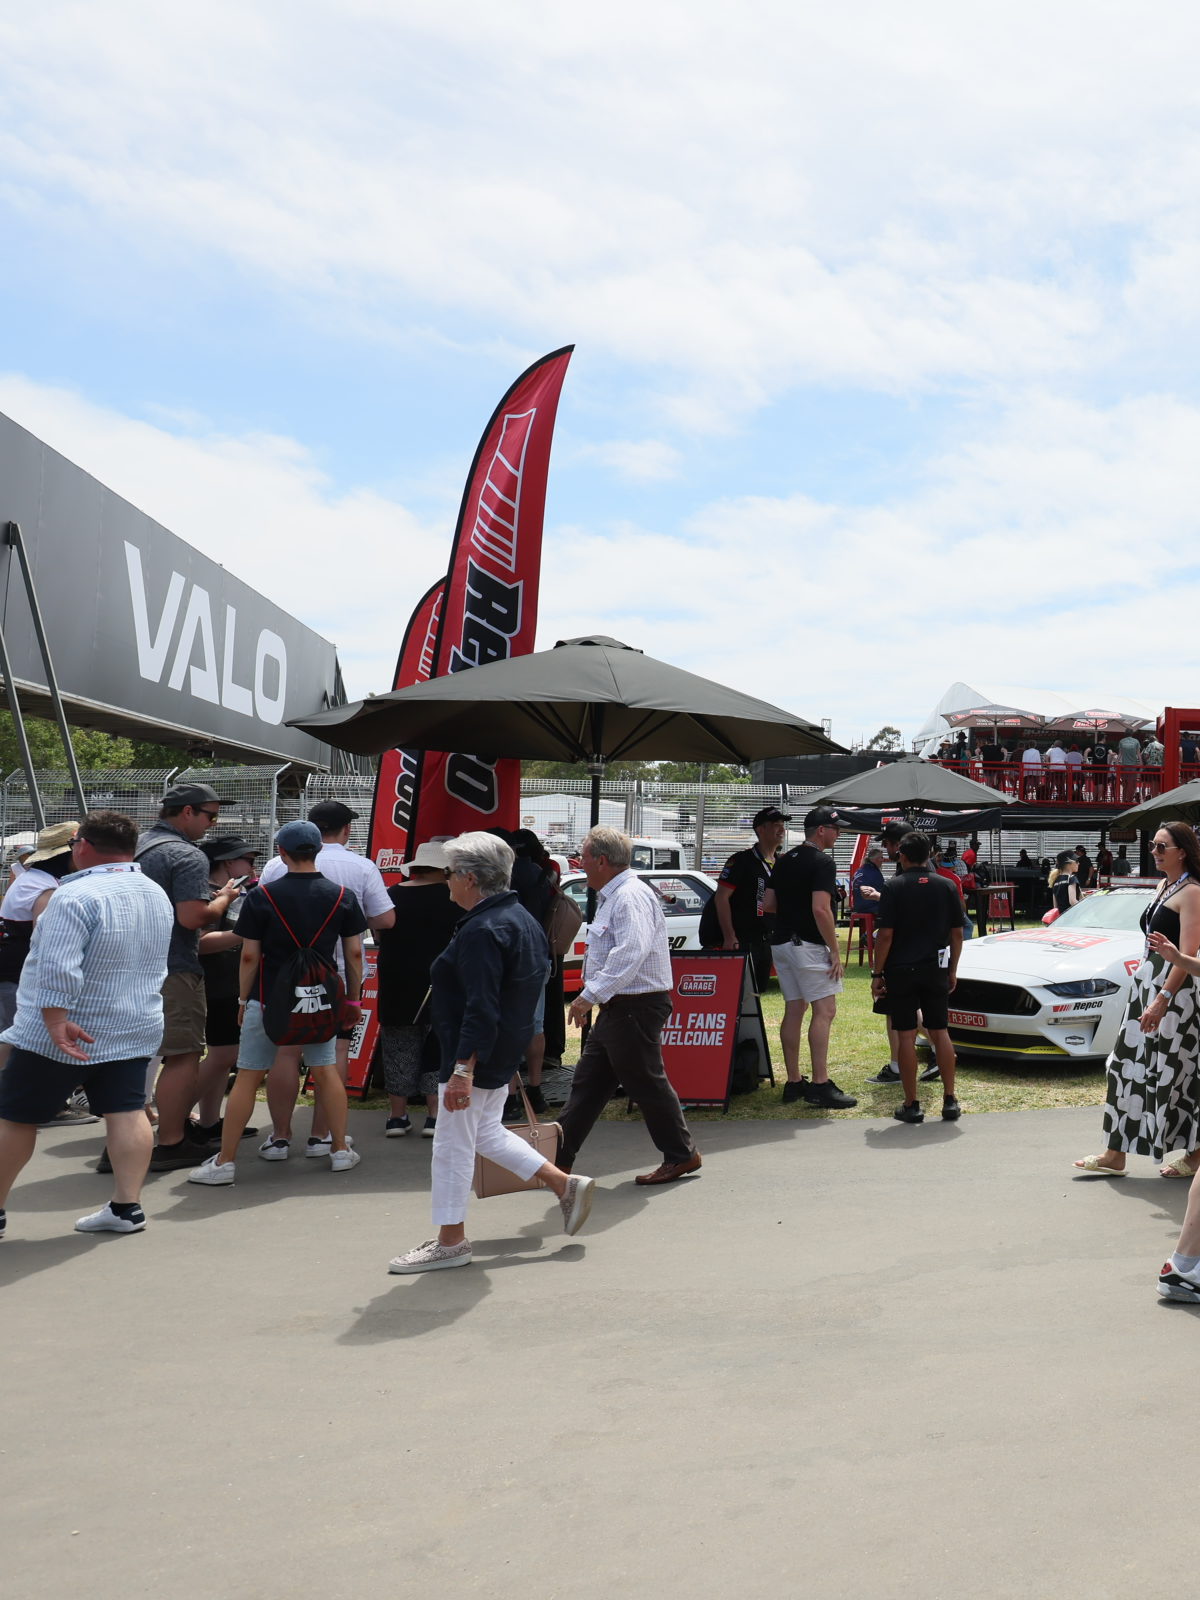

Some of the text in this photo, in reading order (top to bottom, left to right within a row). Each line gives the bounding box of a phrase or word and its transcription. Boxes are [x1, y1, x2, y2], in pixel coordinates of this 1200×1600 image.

[124, 540, 287, 726] VALO
[445, 555, 523, 815] Reo
[380, 856, 405, 868] GARA
[683, 981, 713, 990] GARAGE
[1073, 1001, 1104, 1011] Repco
[687, 1014, 727, 1029] FANS
[952, 1014, 984, 1026] R33PCO
